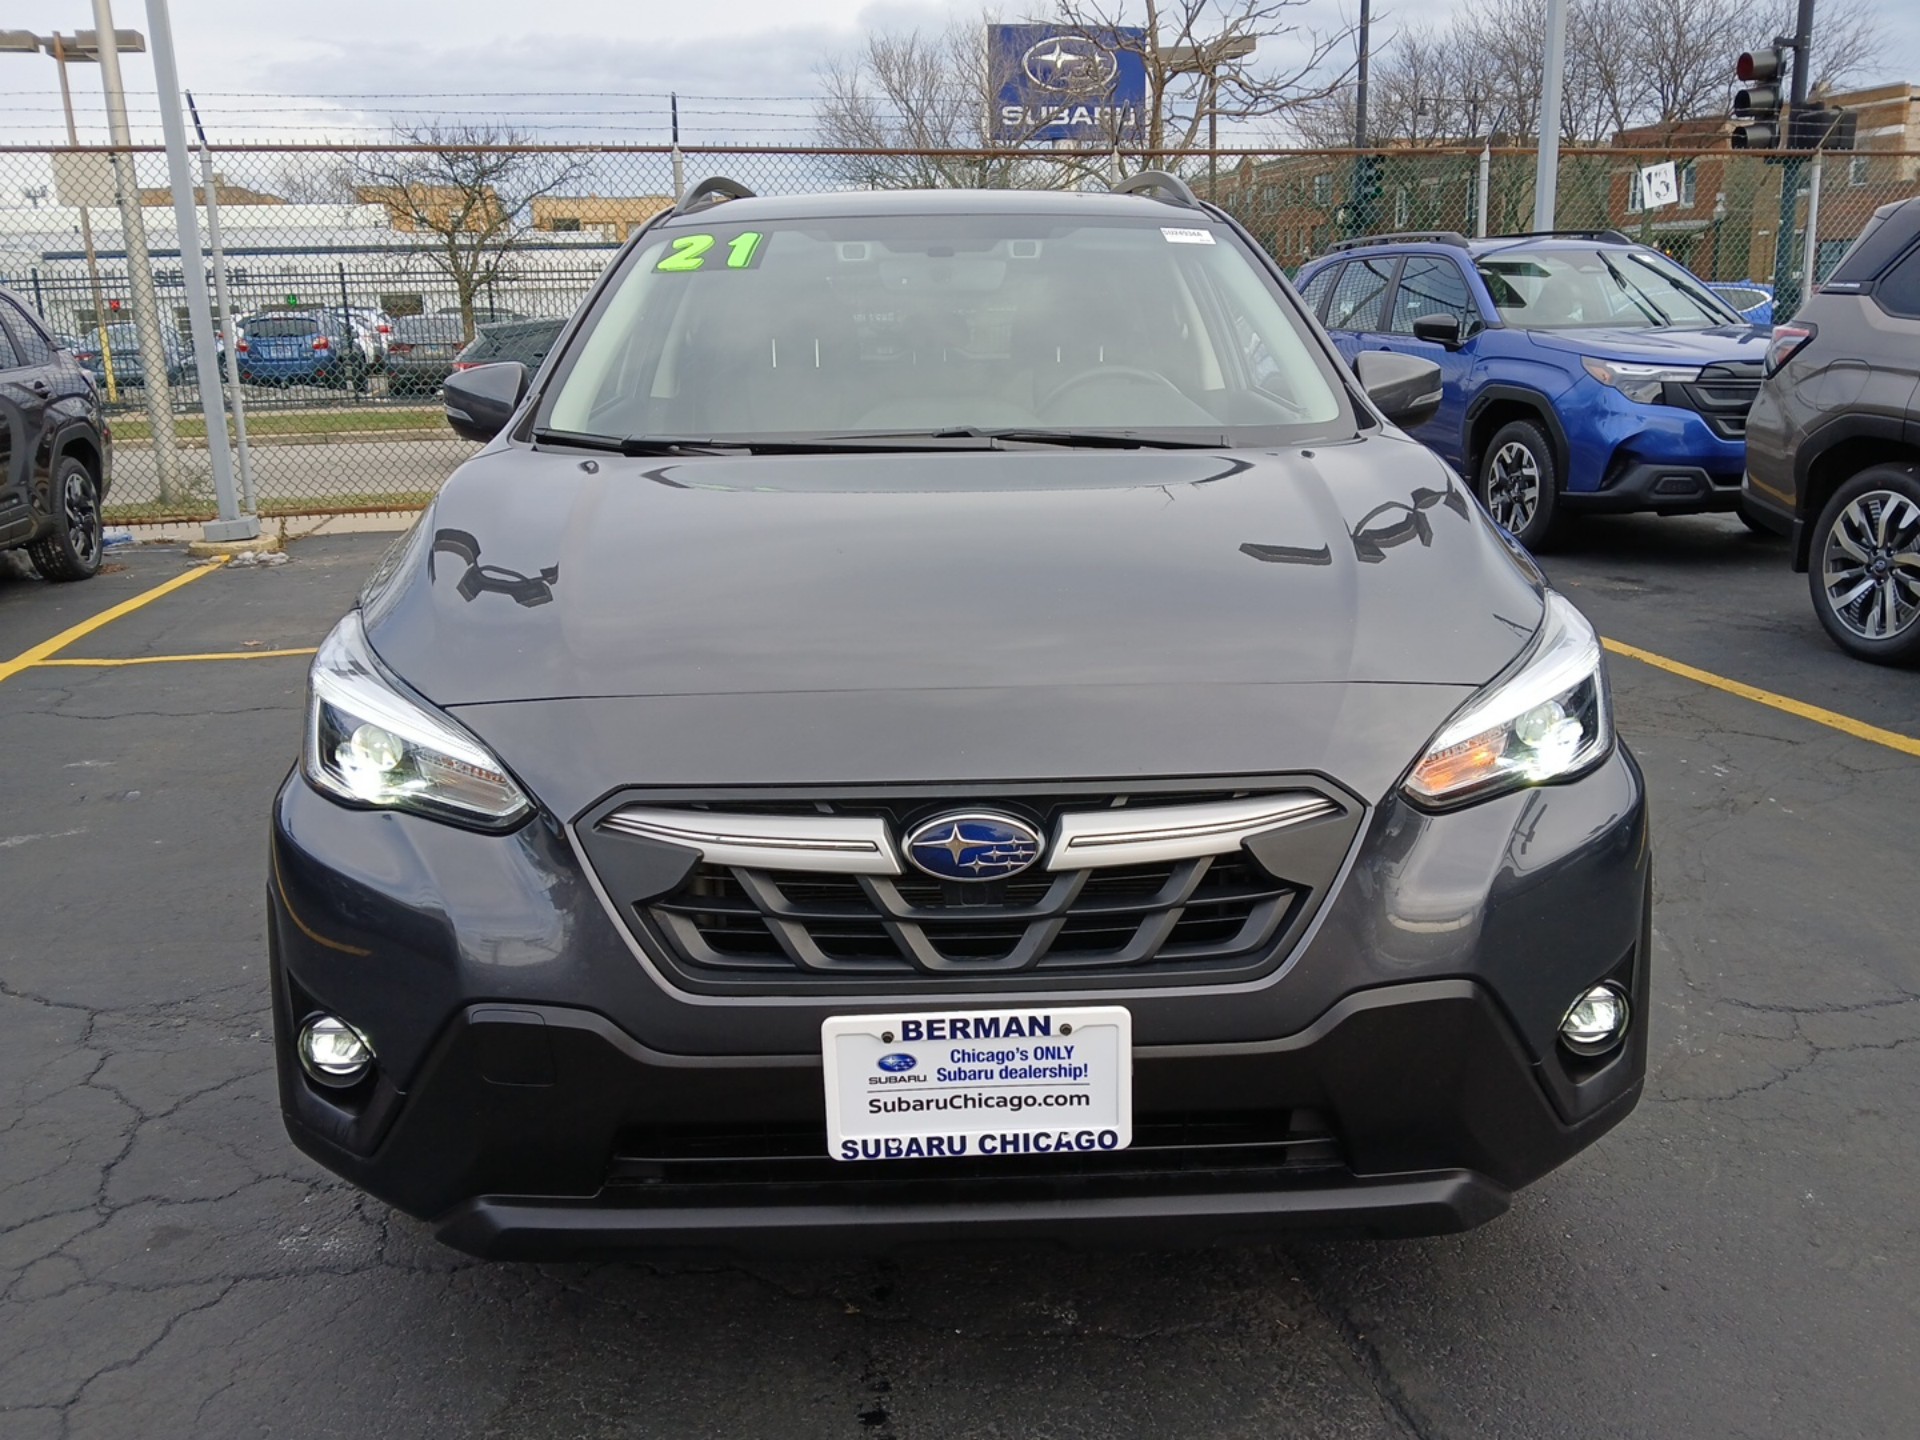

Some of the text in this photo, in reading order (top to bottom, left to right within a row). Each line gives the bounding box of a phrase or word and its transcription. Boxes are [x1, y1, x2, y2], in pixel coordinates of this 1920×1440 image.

[1002, 105, 1136, 126] SUBARU
[657, 230, 764, 272] 21
[901, 1015, 1051, 1042] BERMAN
[950, 1045, 1075, 1066] Chicago's ONLY
[868, 1074, 927, 1085] SUBARU
[936, 1063, 1089, 1082] Subaru dealership!
[868, 1092, 1090, 1114] SubaruChicago.com
[841, 1129, 1119, 1160] SUBARU CHICAGO
